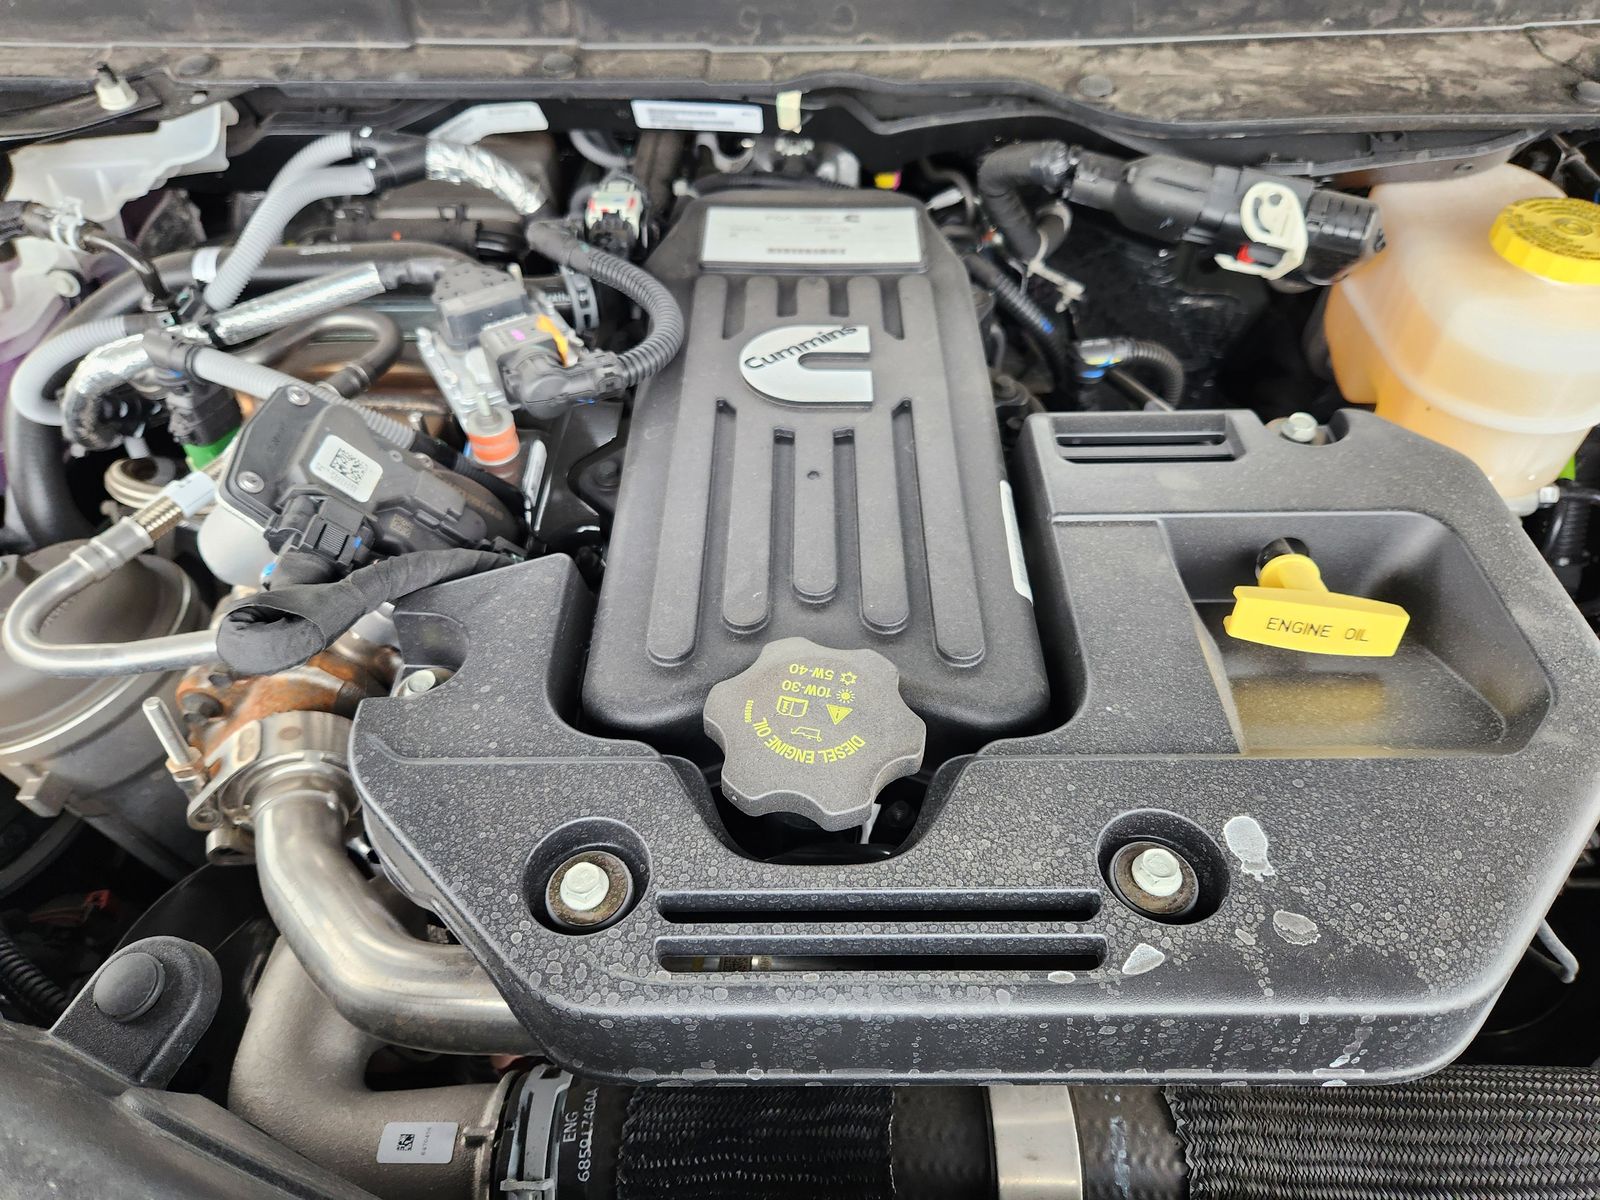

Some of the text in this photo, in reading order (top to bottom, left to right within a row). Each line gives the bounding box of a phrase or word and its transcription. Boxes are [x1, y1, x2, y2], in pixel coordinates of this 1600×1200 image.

[744, 326, 857, 369] Cummins
[1266, 617, 1369, 642] ENGINE OIL
[789, 663, 834, 680] 5W-40
[782, 680, 832, 698] 10W-30
[752, 717, 866, 764] DIESEL ENGINE OIL
[562, 1111, 579, 1143] ENG
